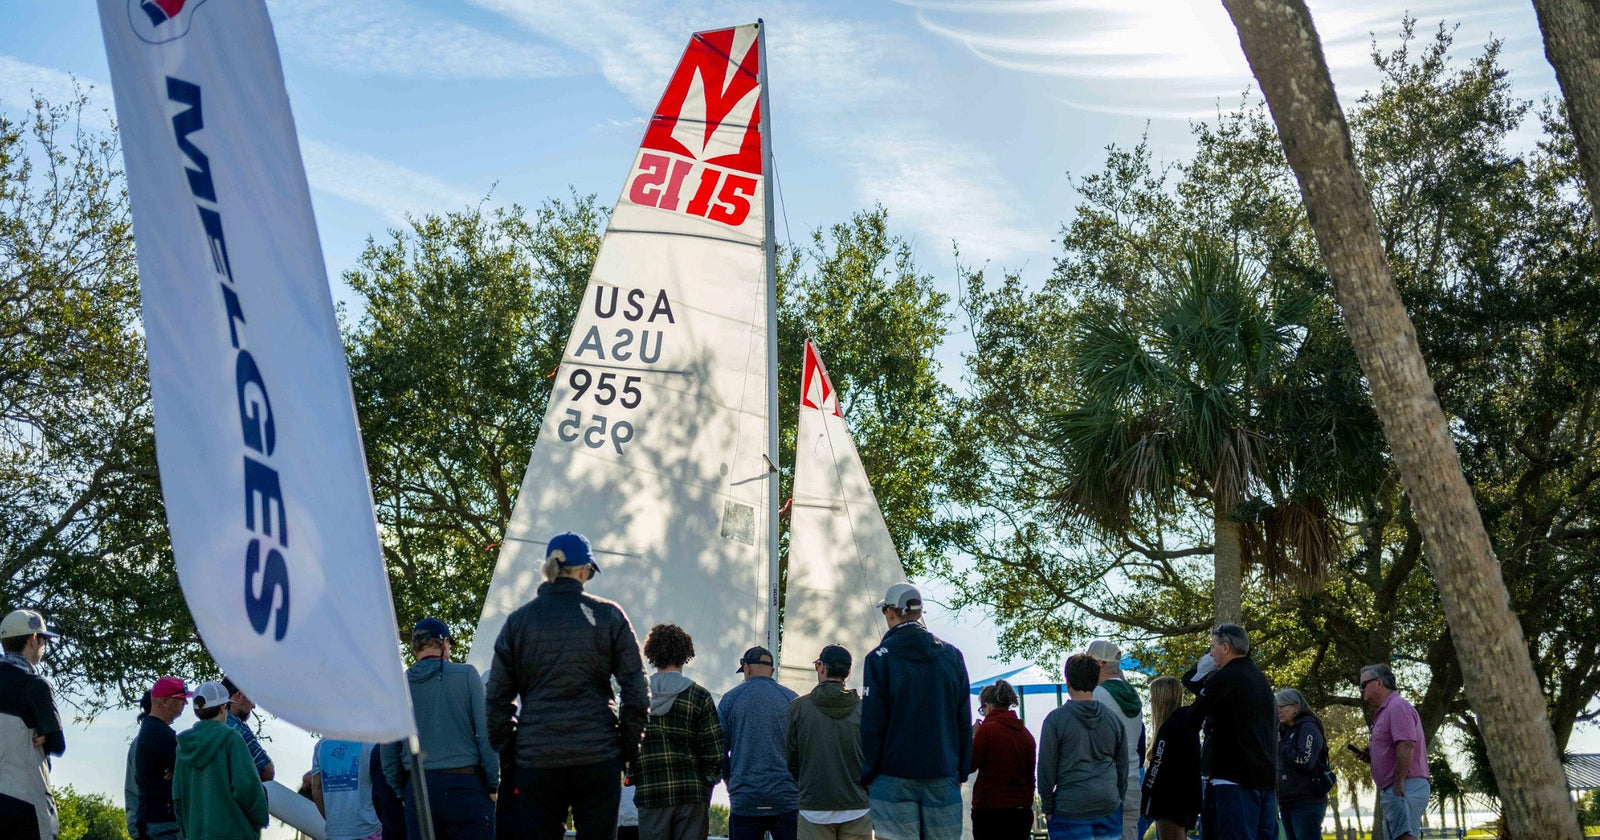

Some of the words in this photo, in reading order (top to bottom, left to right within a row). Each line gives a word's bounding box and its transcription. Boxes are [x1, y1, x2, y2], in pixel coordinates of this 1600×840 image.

[686, 167, 758, 226] 15
[594, 285, 675, 324] USA
[165, 75, 290, 642] MELGES
[569, 368, 642, 409] 955
[1146, 739, 1165, 789] carhartt
